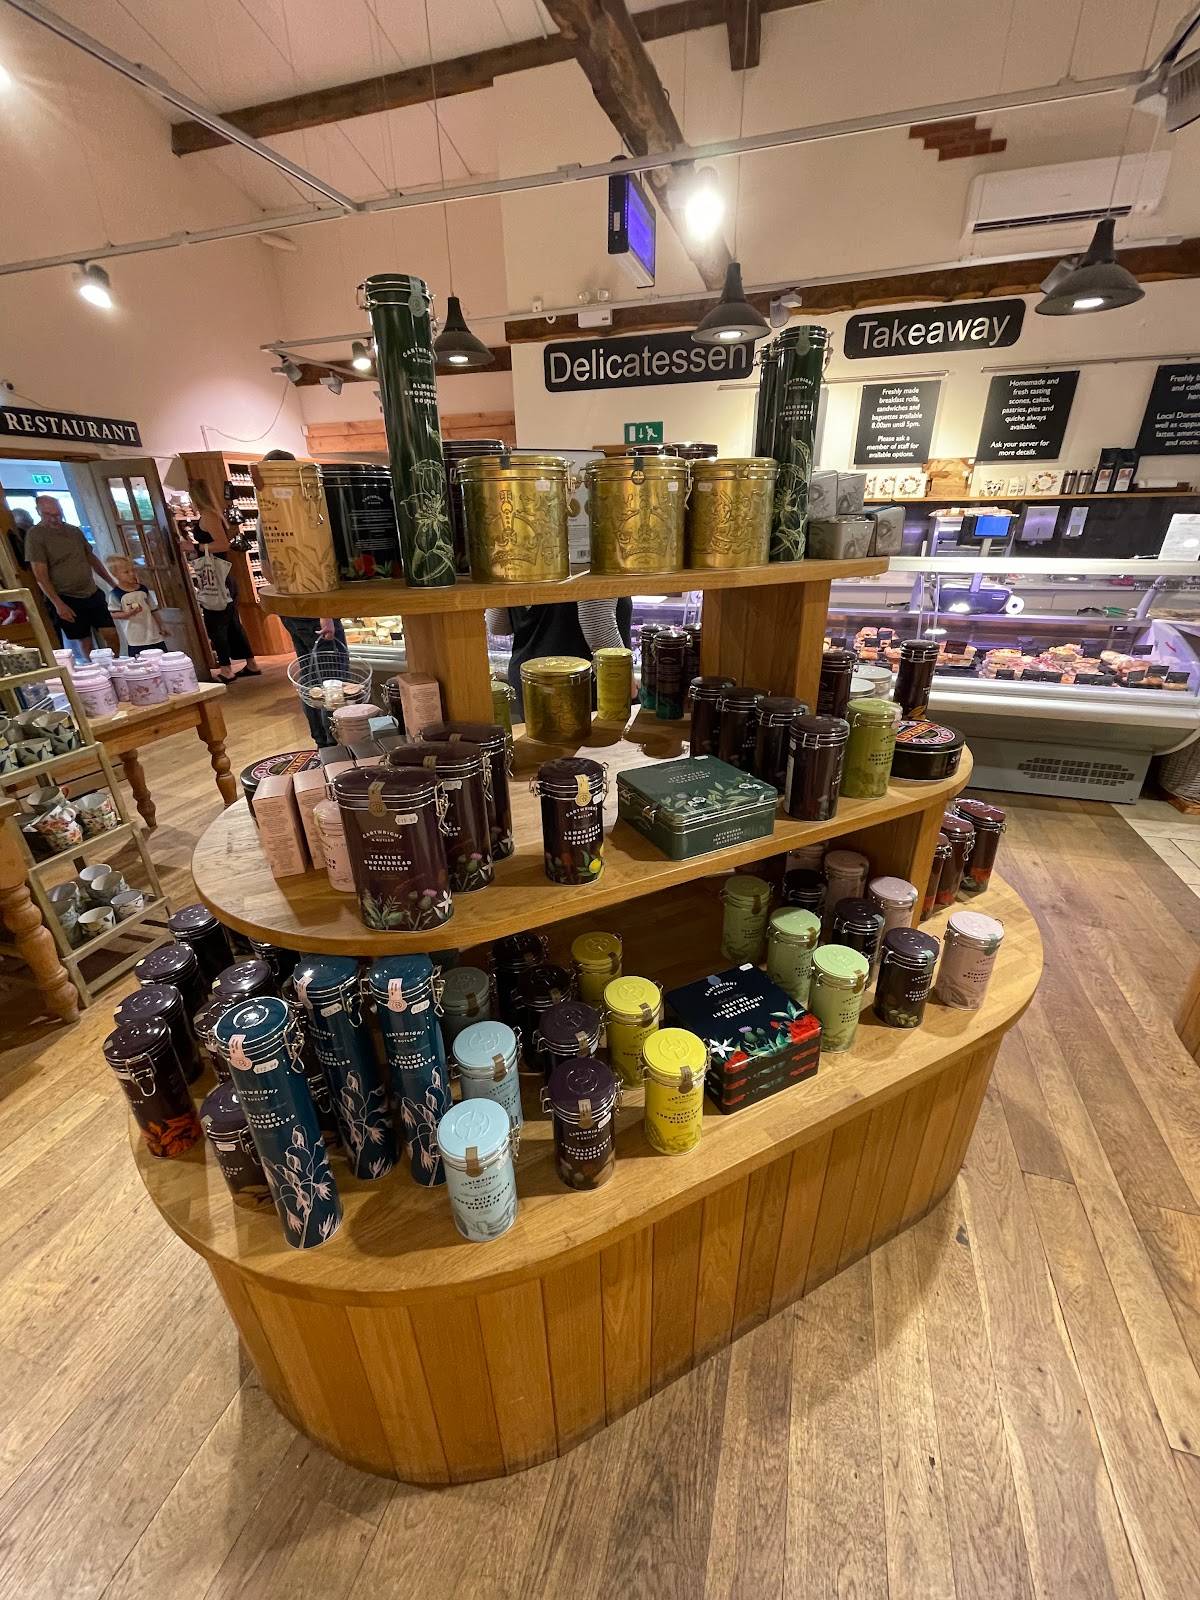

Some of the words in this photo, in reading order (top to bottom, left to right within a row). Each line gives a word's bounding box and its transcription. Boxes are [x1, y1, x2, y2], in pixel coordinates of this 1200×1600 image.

[858, 313, 1011, 350] Takeaway
[549, 344, 747, 384] Delicatessen
[1009, 378, 1046, 387] Homemade
[1046, 377, 1060, 385] and
[1170, 374, 1195, 383] Freshly
[882, 387, 903, 396] Freshly
[903, 386, 920, 394] made
[1012, 388, 1029, 396] fresh
[879, 396, 905, 404] breakfast
[876, 405, 908, 413] sandwiches
[908, 403, 921, 411] and
[1027, 406, 1041, 414] pies
[1041, 404, 1055, 412] and
[871, 414, 899, 422] baguettes
[1004, 415, 1026, 424] quiche
[1026, 414, 1047, 423] always
[1156, 412, 1175, 420] Local
[3, 412, 137, 442] RESTAURANT
[892, 420, 906, 428] until
[1009, 423, 1037, 431] available.
[895, 434, 906, 442] ask
[897, 442, 910, 450] staff
[1003, 441, 1019, 449] your
[1019, 440, 1039, 448] server
[1039, 439, 1050, 447] for
[362, 830, 403, 839] CARTWRIGHT
[704, 982, 737, 997] CARTWRIGHT
[712, 1005, 737, 1018] LUXURY
[738, 995, 764, 1008] BISCUIT
[721, 996, 749, 1009] TEATIME
[725, 1002, 761, 1019] SELECTION
[394, 1056, 425, 1065] CARAMEL
[399, 1055, 436, 1070] CRUMBLES
[560, 1142, 597, 1153] CHOCOLATE
[453, 1196, 491, 1206] CHOCOLATE
[467, 1198, 500, 1210] BISCUITS
